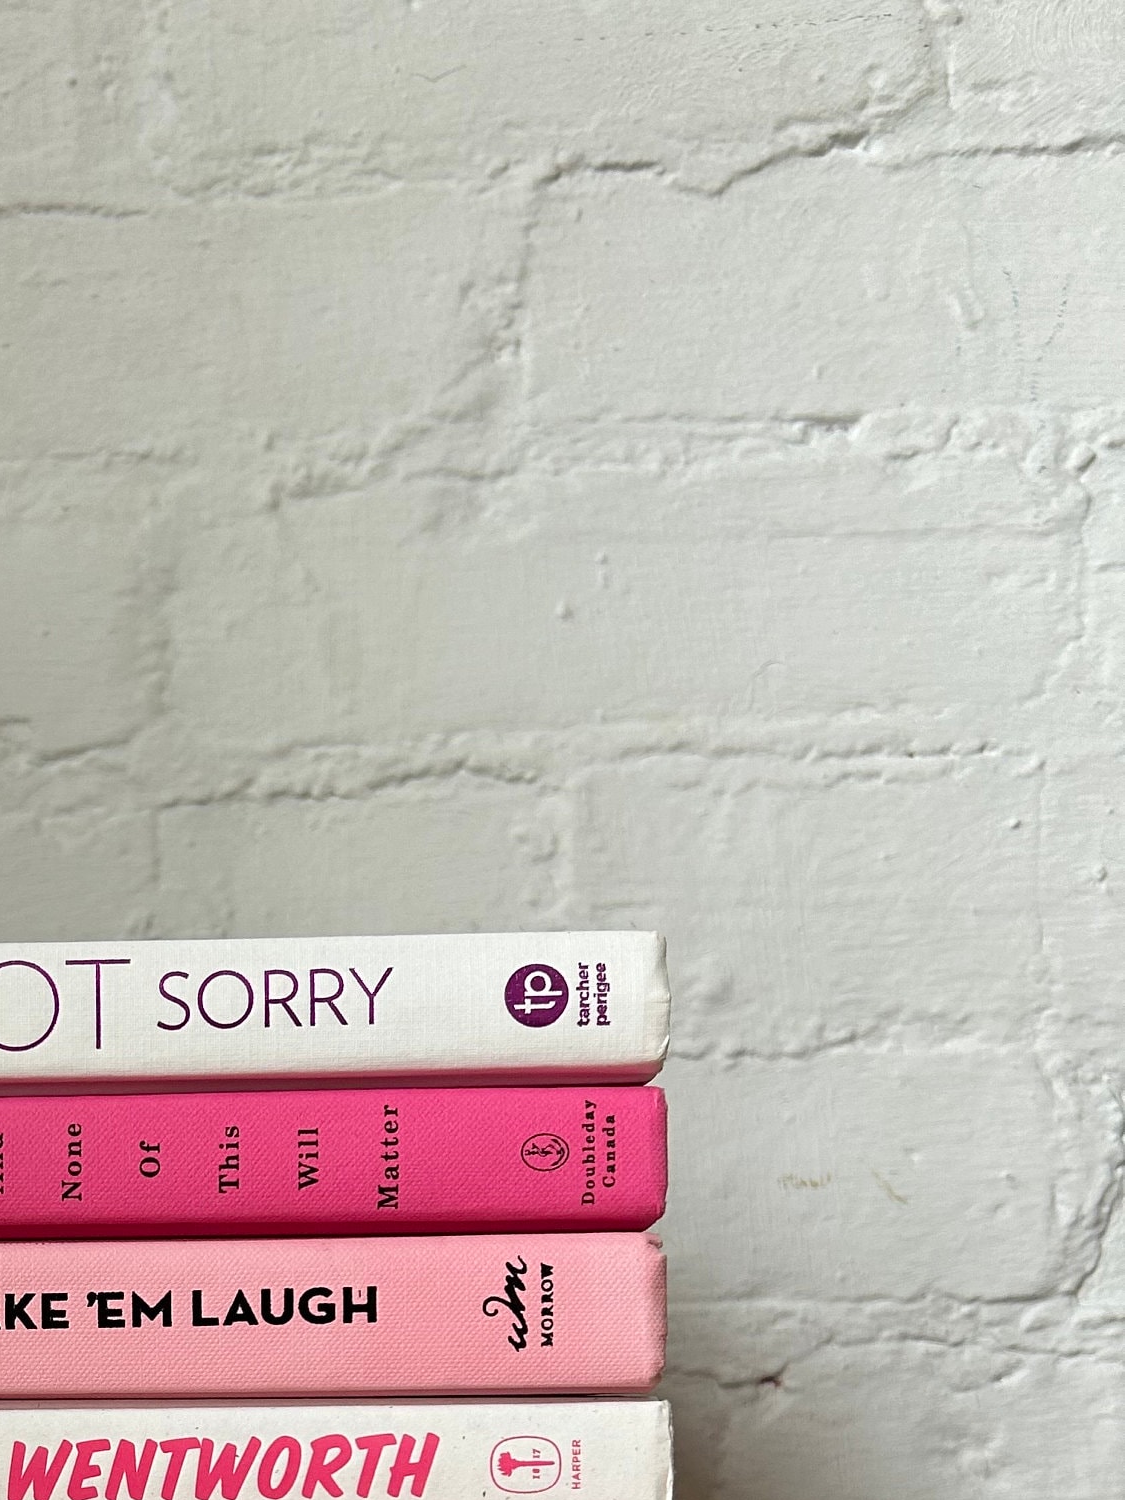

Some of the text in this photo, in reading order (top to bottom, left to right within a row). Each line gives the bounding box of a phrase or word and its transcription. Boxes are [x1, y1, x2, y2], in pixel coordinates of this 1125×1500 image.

[157, 967, 392, 1030] SORRY
[576, 963, 590, 1027] tarcher
[594, 962, 612, 1027] perigee
[62, 1124, 82, 1201] None
[140, 1141, 160, 1178] Of
[219, 1126, 239, 1193] This
[298, 1128, 319, 1190] Will
[377, 1105, 399, 1210] Matter
[581, 1100, 596, 1205] Doubleday
[602, 1115, 615, 1187] Canada
[87, 1290, 172, 1328] 'EM
[192, 1286, 377, 1326] LAUGH
[541, 1263, 553, 1347] MORROW
[572, 1440, 581, 1489] HARPER
